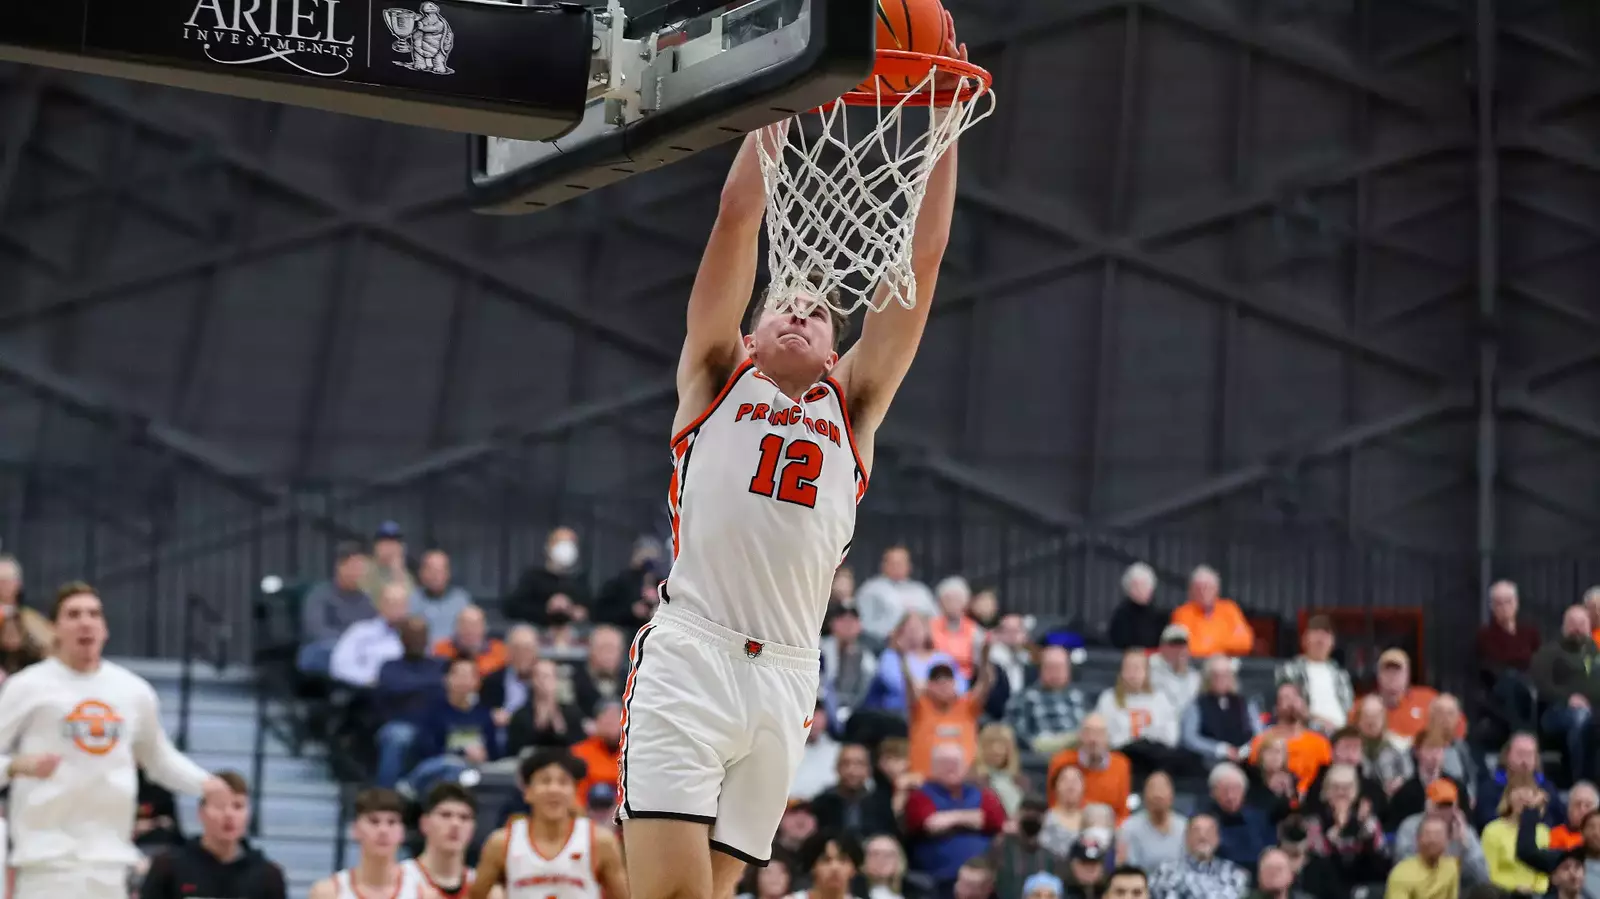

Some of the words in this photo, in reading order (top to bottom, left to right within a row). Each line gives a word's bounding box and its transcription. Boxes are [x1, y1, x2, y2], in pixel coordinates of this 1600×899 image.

[183, 0, 355, 45] ARIEL
[183, 28, 354, 58] INVESTMENTS
[734, 403, 841, 448] PRINCON
[748, 433, 824, 509] 12
